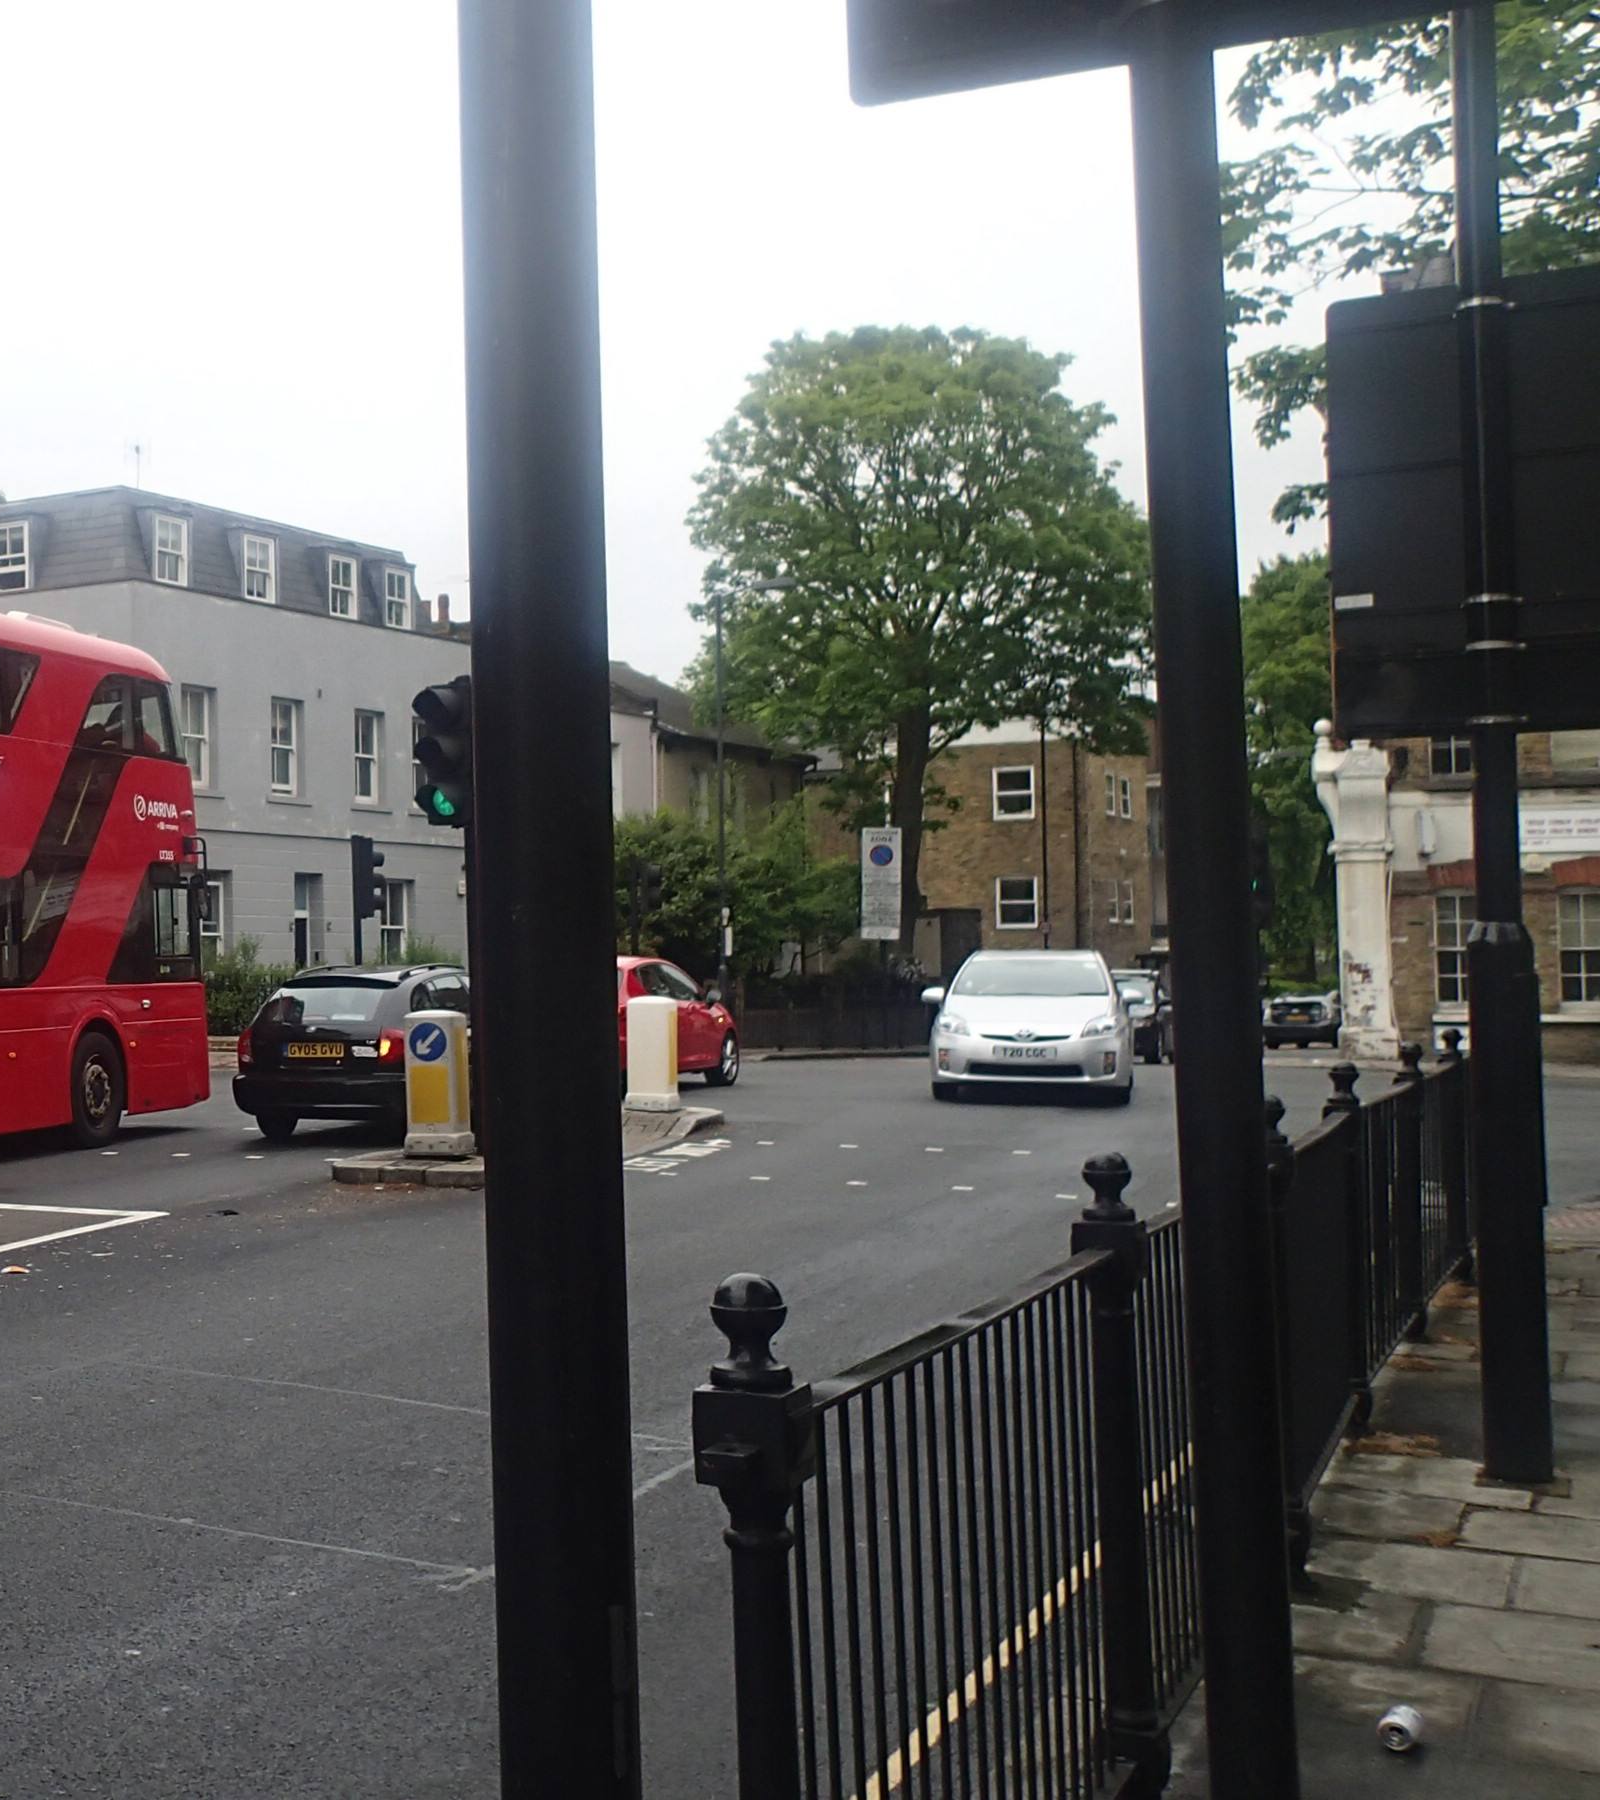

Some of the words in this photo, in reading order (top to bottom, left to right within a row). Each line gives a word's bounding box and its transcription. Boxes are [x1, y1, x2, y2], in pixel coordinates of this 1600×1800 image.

[147, 800, 179, 819] ARRIVA
[289, 1043, 318, 1056] GY05
[320, 1043, 342, 1056] GVU
